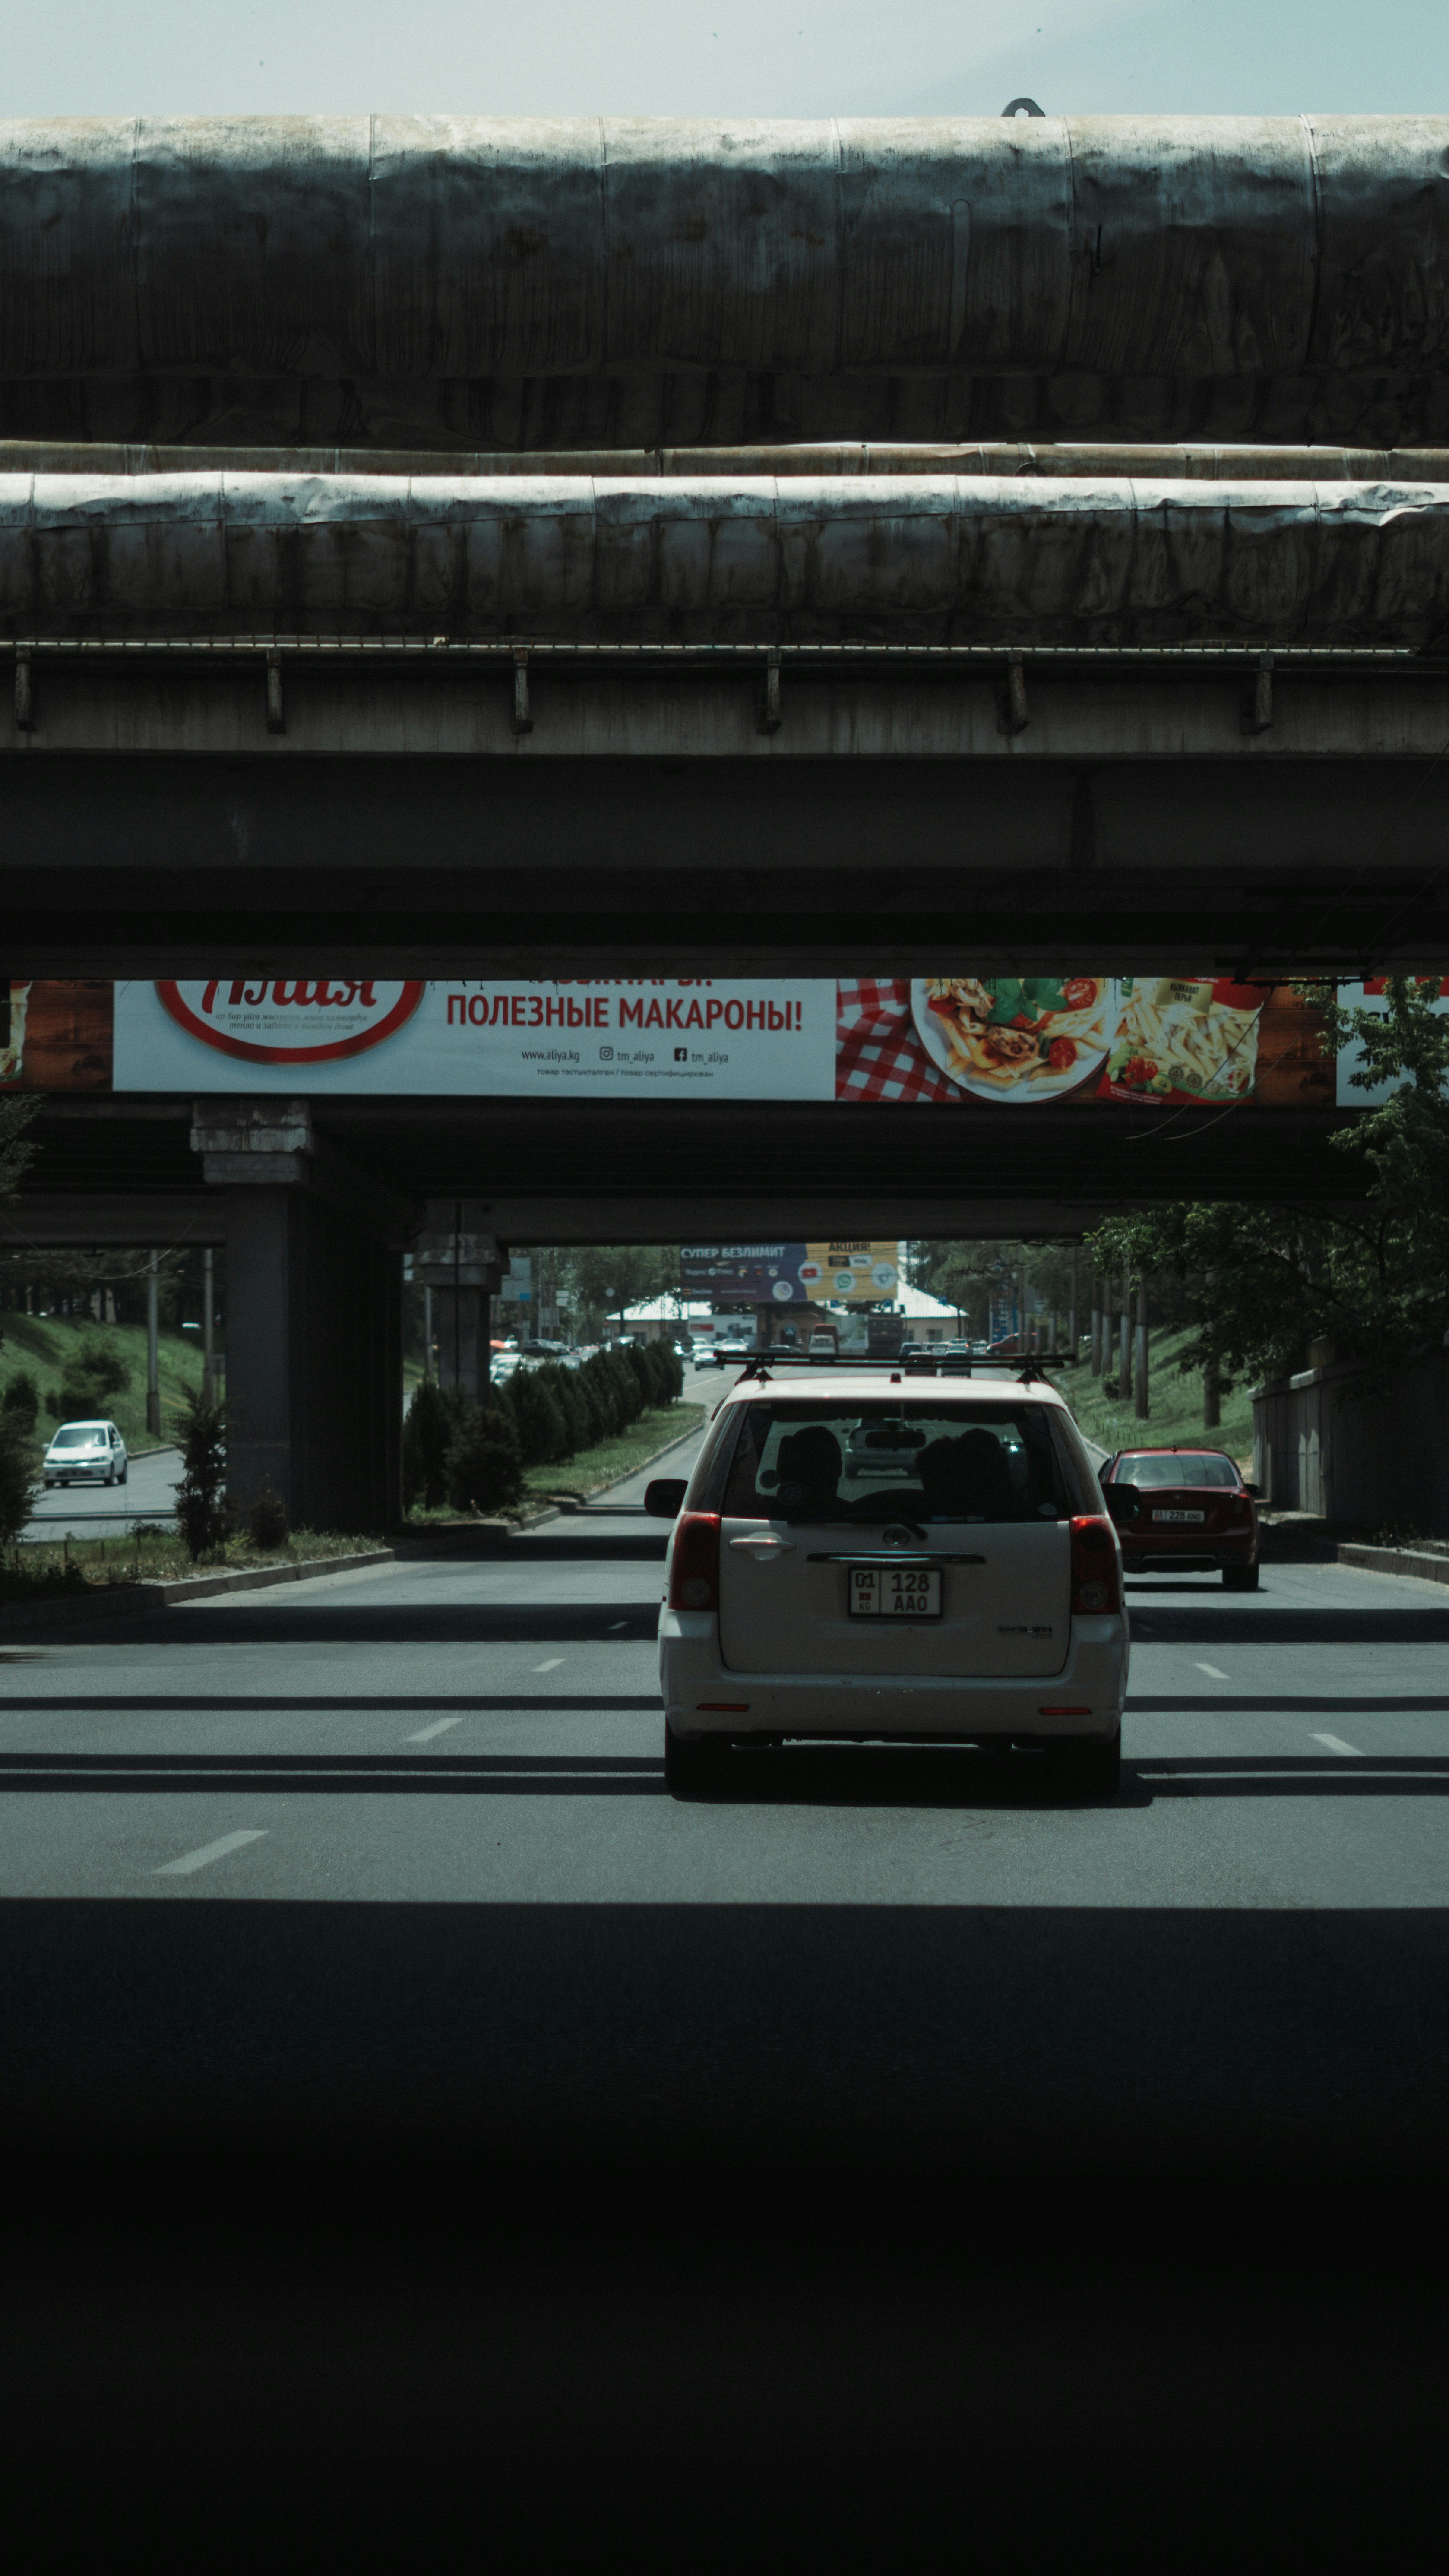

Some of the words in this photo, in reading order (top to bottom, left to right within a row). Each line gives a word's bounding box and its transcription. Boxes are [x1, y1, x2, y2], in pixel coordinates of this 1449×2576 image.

[227, 1013, 241, 1021] бир
[447, 996, 609, 1028] ПОЛЕЗНЫЕ
[620, 999, 802, 1031] МАКАРОНЫ!
[522, 1050, 579, 1063] www.aliya.kg
[617, 1051, 654, 1063] tm_aliya
[692, 1053, 728, 1065] tm_aliya
[680, 1248, 719, 1258] СУПЕР
[721, 1247, 785, 1257] БЕЗЛИМИТ
[829, 1242, 870, 1253] АКЦИЯ!
[1169, 1511, 1185, 1519] 228
[856, 1573, 875, 1587] 01
[892, 1573, 929, 1592] 128
